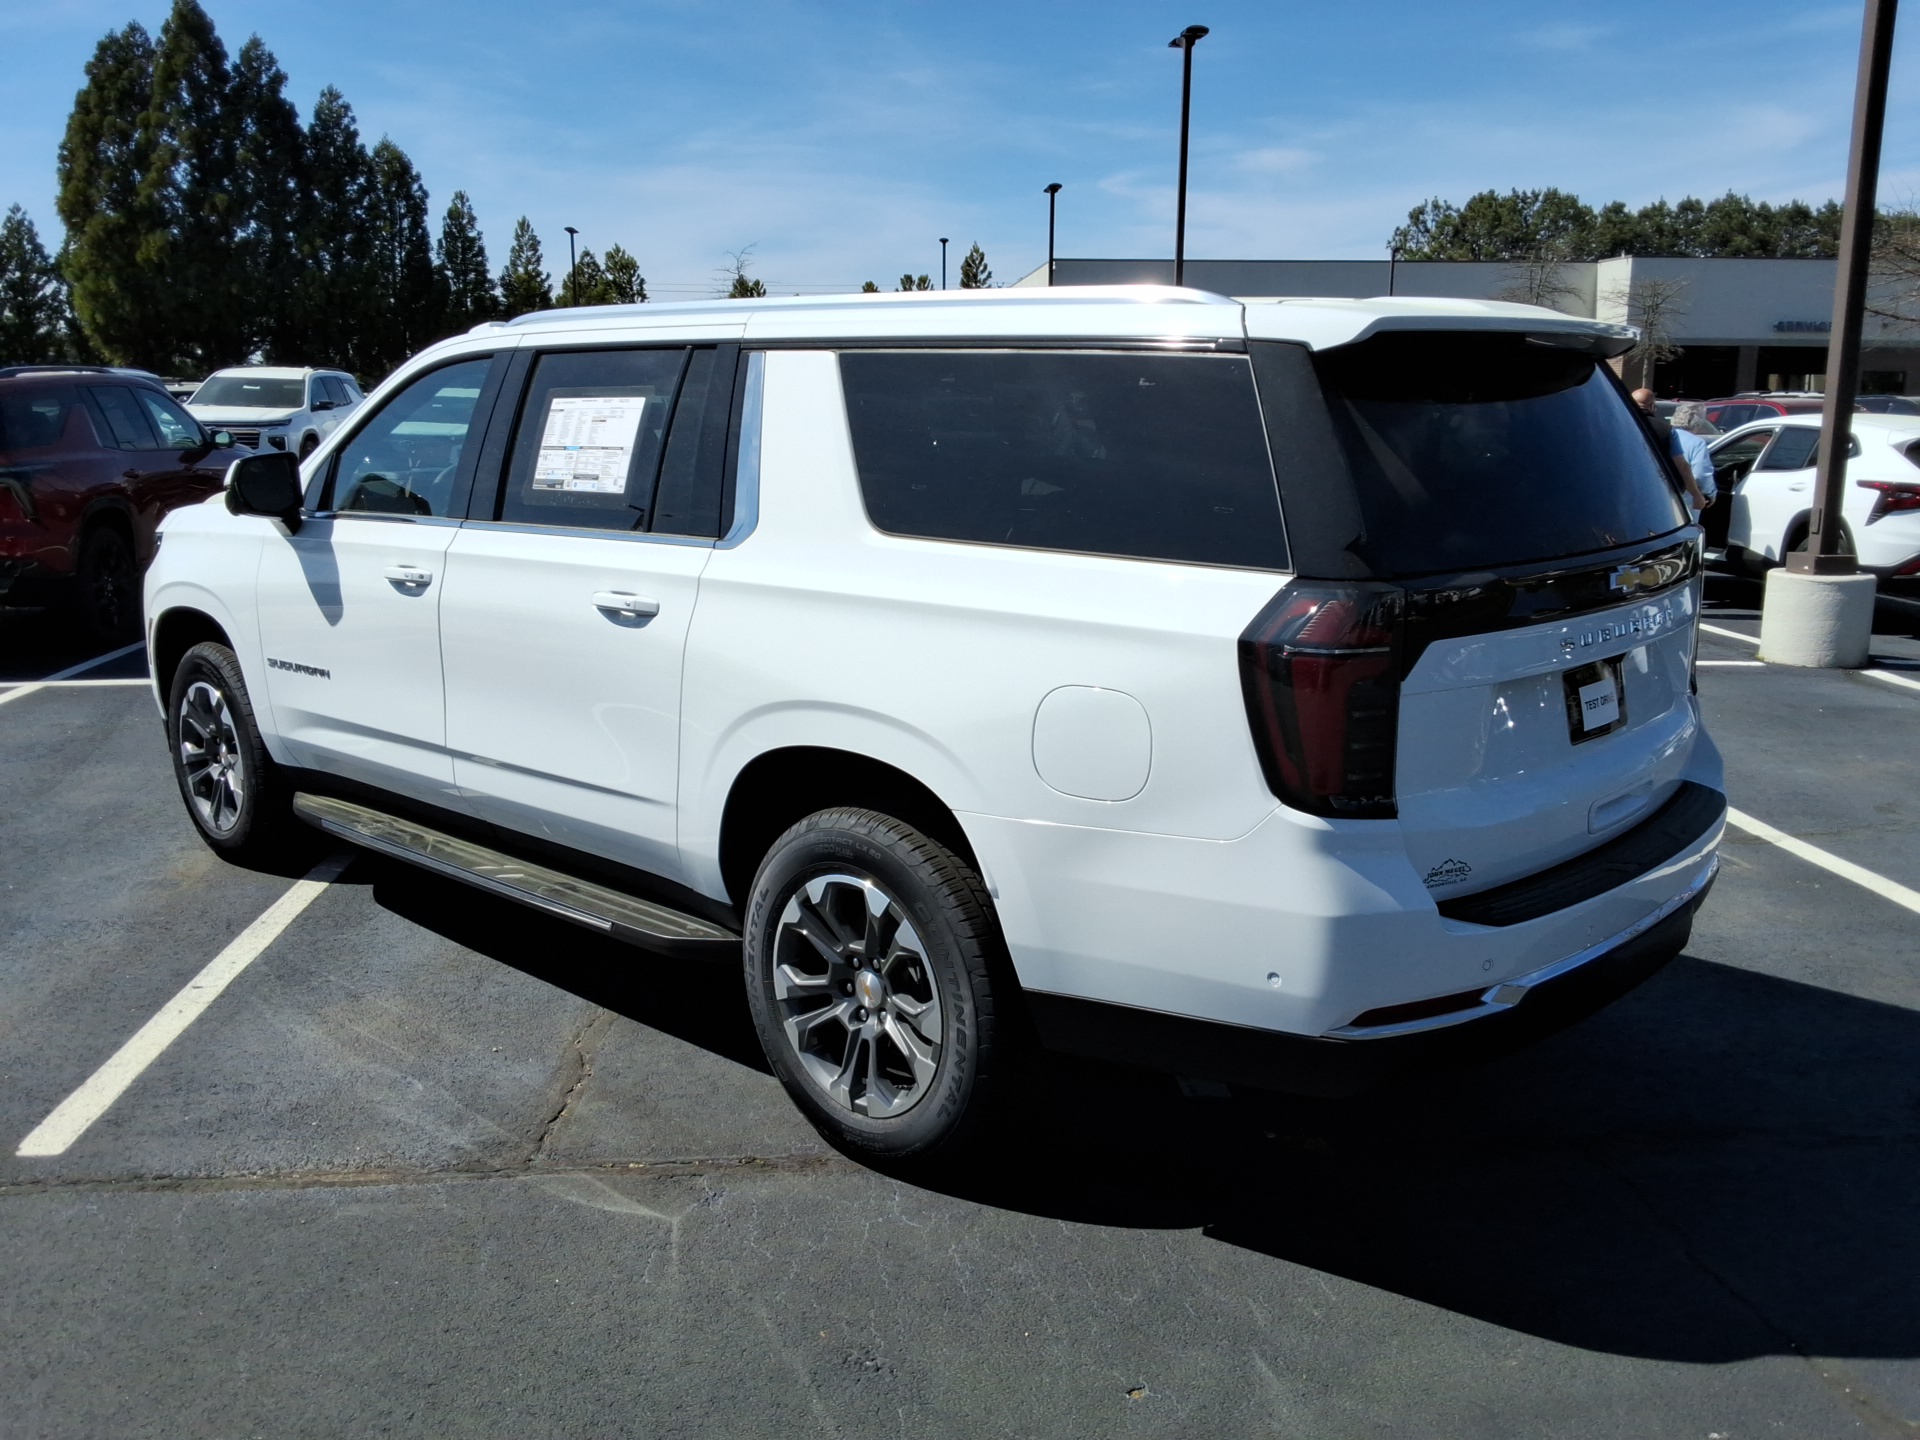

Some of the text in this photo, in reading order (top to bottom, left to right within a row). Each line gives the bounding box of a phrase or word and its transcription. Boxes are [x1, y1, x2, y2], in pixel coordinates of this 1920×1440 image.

[1560, 608, 1674, 651] SUBURBAN
[267, 657, 331, 680] SUBURBAN
[1584, 697, 1600, 711] TEST
[1425, 871, 1443, 882] JOHN
[1426, 879, 1458, 889] AWSONVILLE,
